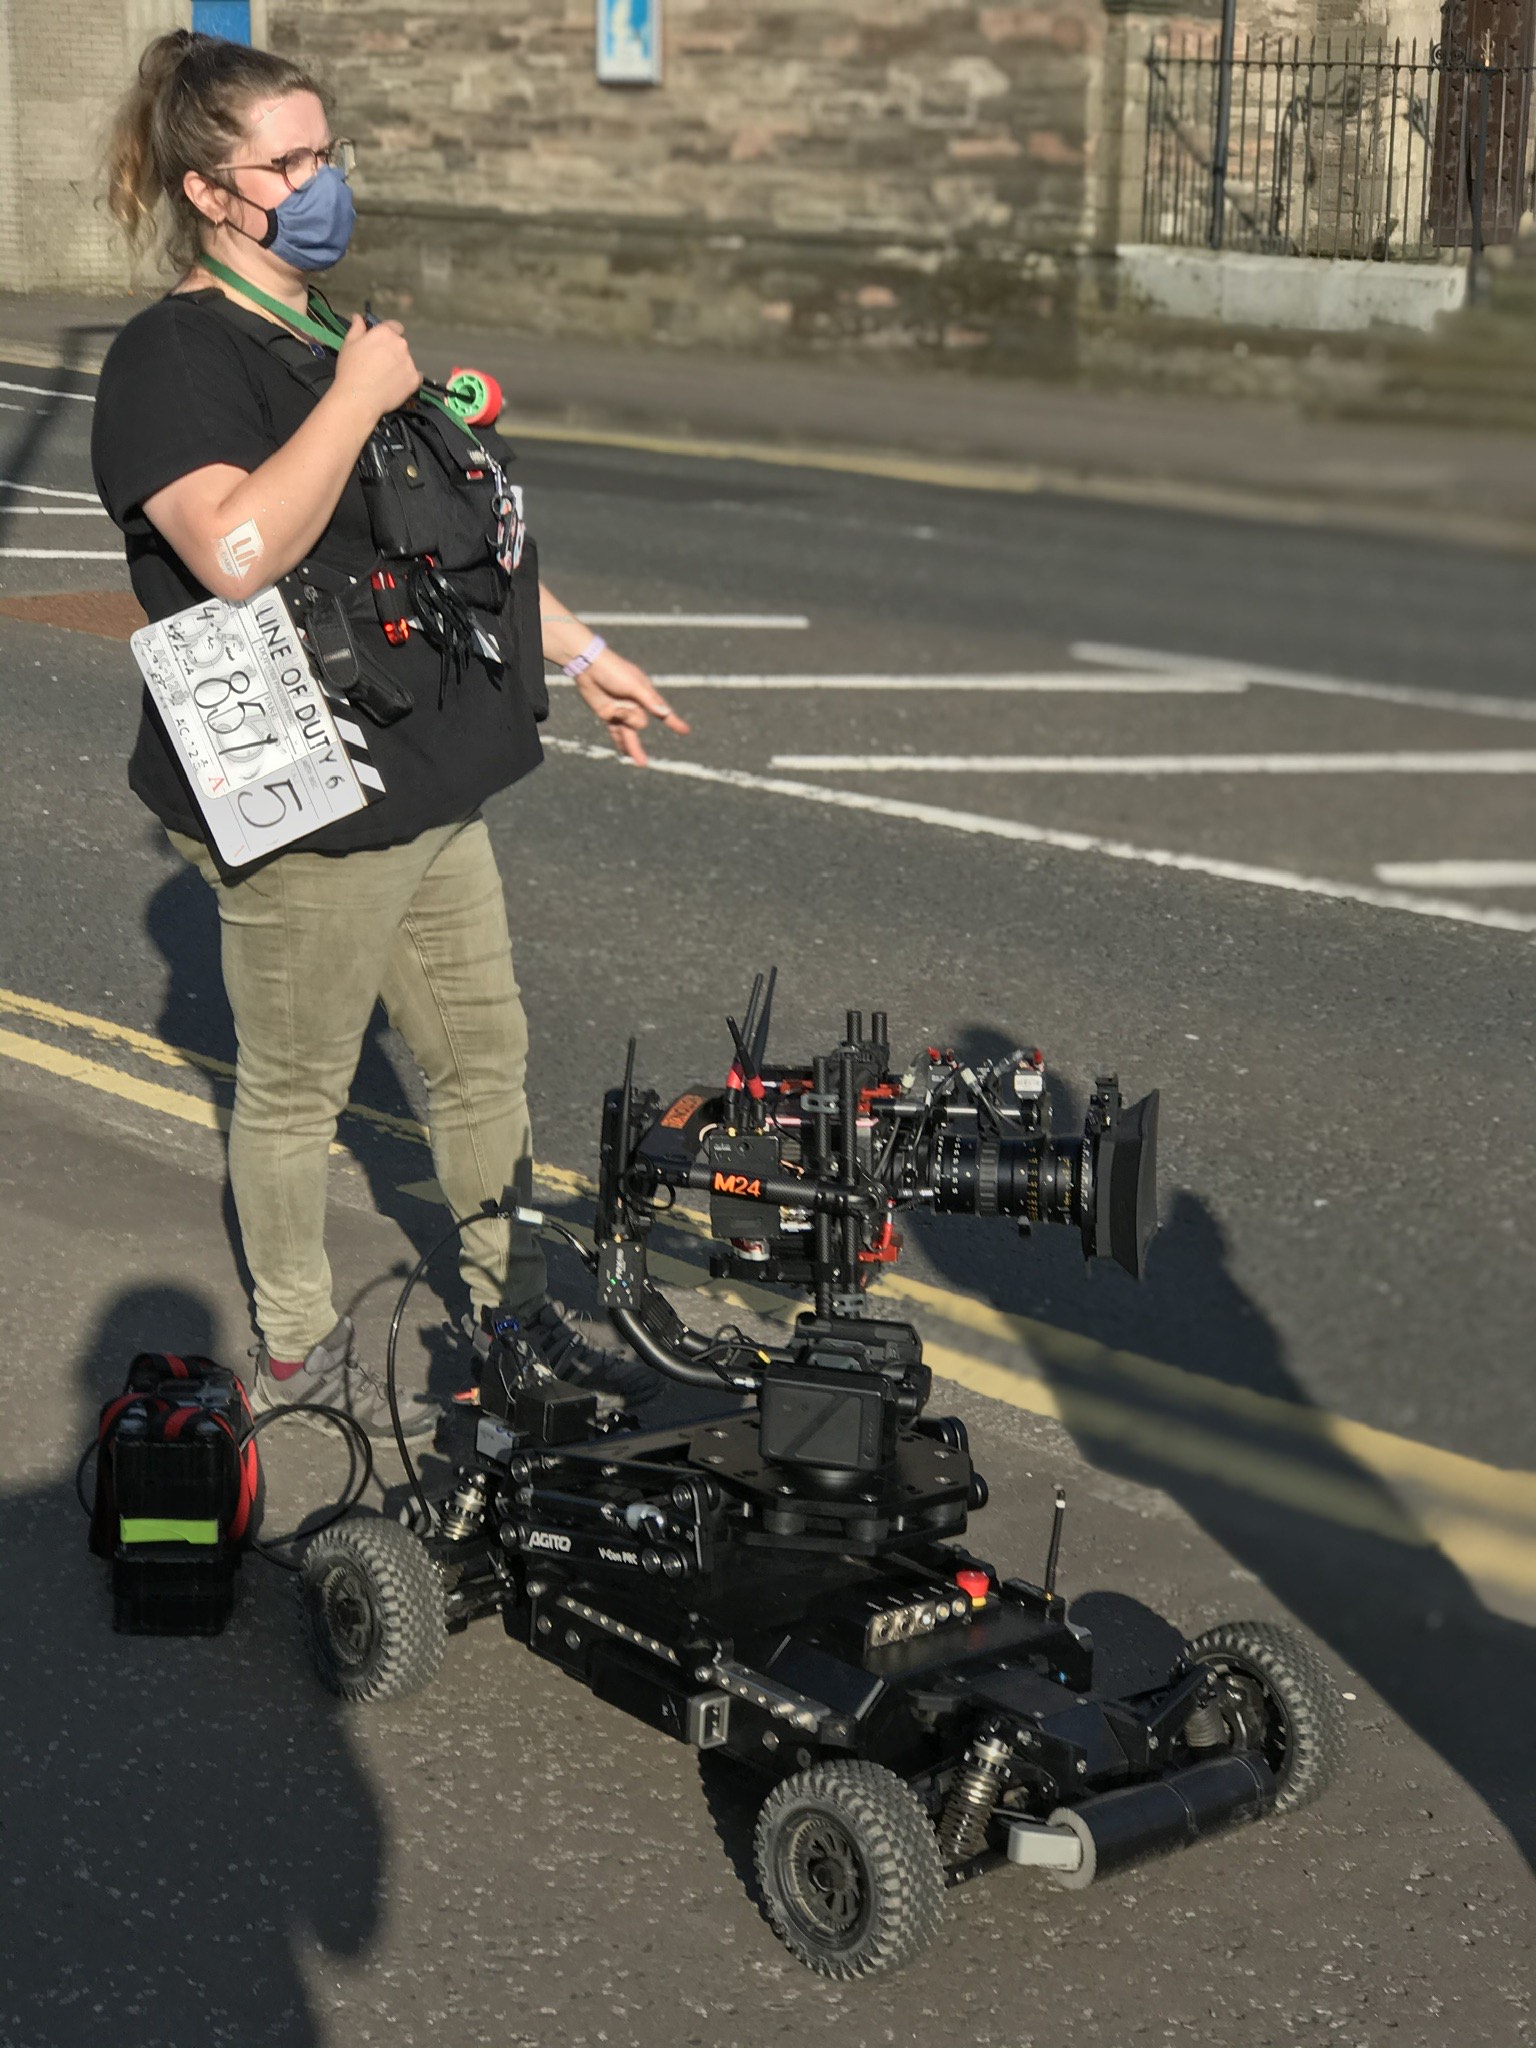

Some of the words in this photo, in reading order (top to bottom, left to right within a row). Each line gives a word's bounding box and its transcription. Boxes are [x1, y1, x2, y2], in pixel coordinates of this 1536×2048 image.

[255, 606, 292, 661] LINE
[280, 667, 309, 697] OF
[295, 703, 338, 764] DUTY
[325, 774, 346, 790] 6
[264, 695, 279, 721] TAKE
[237, 777, 303, 828] 5
[714, 1171, 761, 1198] M24
[528, 1530, 572, 1553] AGITO
